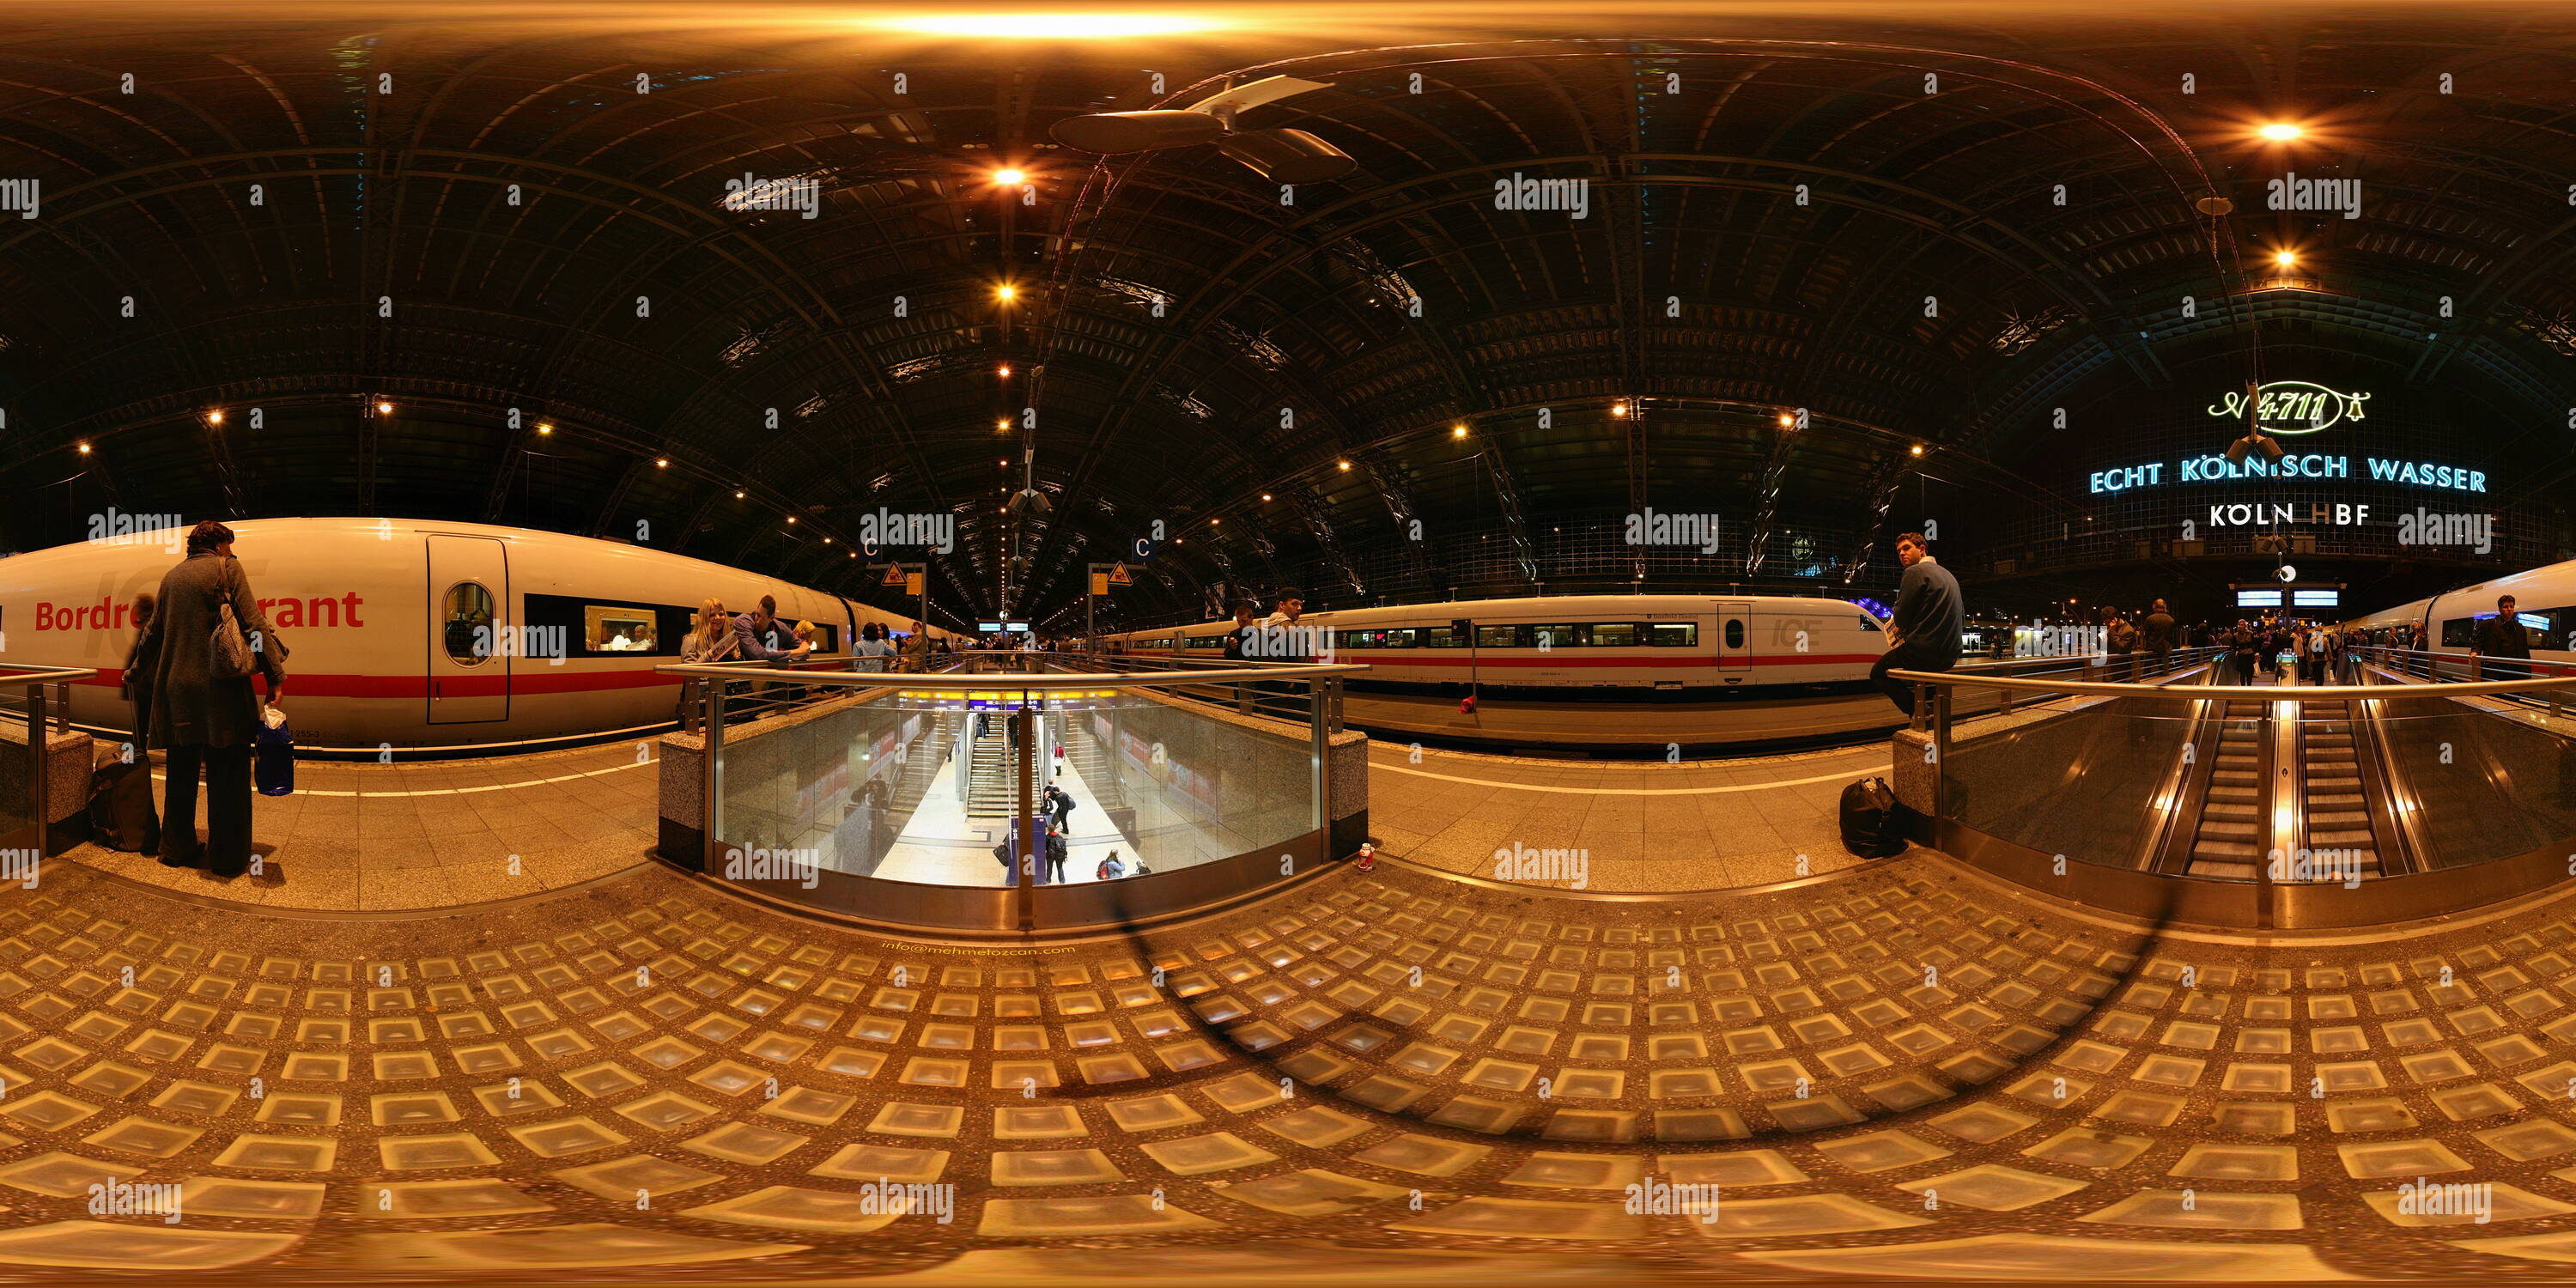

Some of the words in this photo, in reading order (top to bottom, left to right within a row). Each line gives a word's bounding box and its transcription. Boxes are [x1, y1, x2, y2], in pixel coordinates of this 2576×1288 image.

[2257, 392, 2328, 421] 4711
[2091, 463, 2163, 493] ECHT
[2181, 453, 2347, 482] KÖLNISCH
[2368, 458, 2486, 492] WASSER
[2210, 503, 2293, 526] KÖLN
[2312, 503, 2369, 526] HBF
[864, 538, 878, 556] C
[1136, 538, 1150, 556] C
[1771, 618, 1822, 647] ICE
